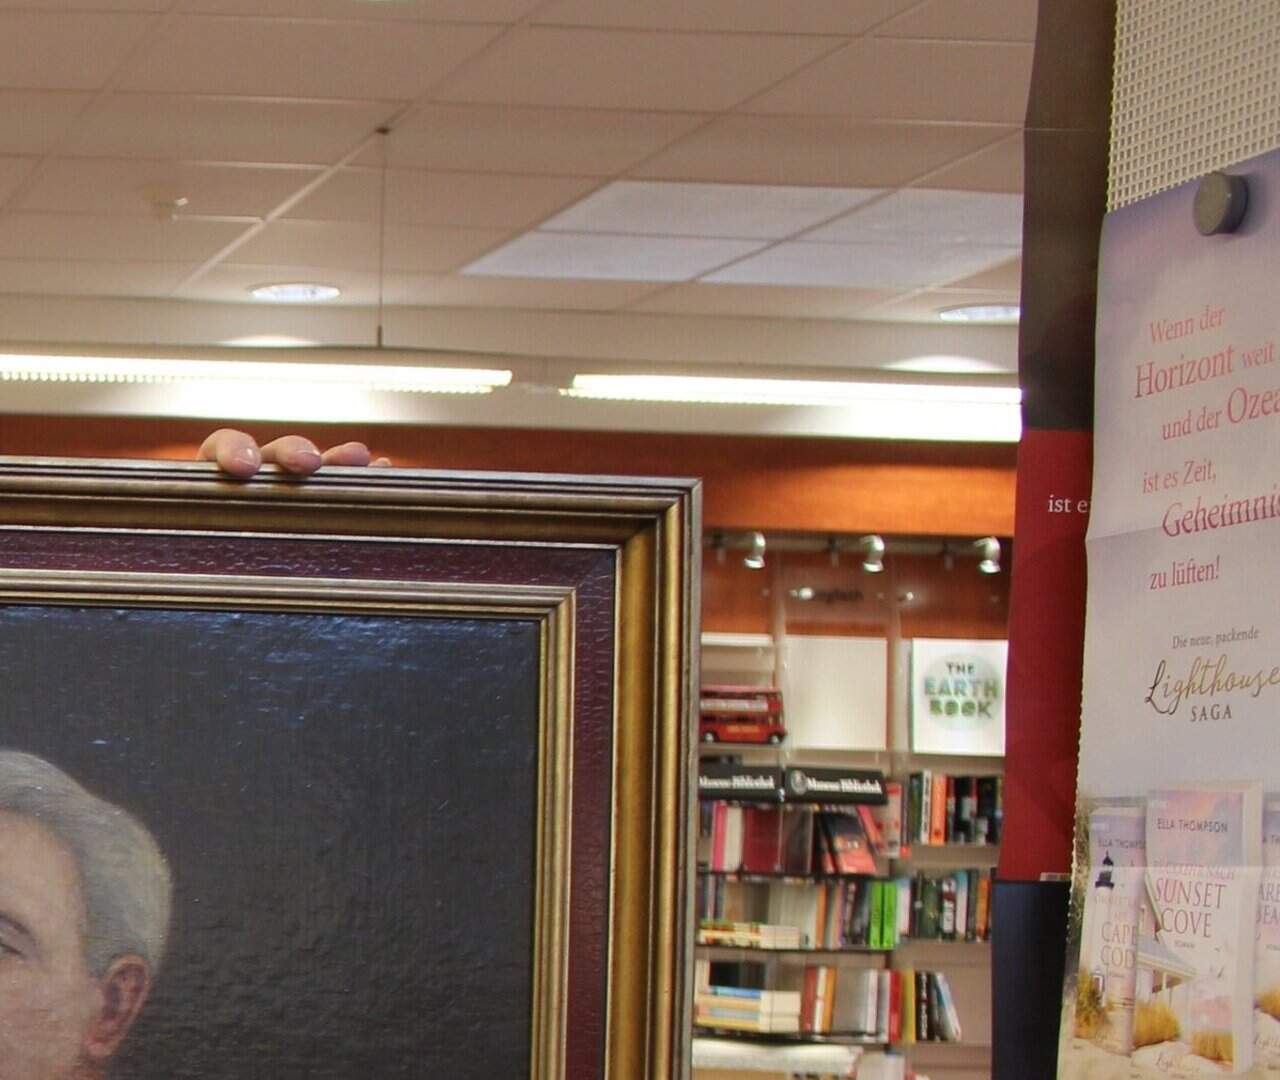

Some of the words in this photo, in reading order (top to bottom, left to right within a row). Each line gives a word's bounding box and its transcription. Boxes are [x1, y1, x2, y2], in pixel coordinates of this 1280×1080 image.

[1149, 317, 1195, 345] Wenn
[1199, 304, 1225, 331] der
[1134, 345, 1235, 399] Horizont
[1241, 341, 1276, 369] weit
[1161, 409, 1192, 441] und
[1196, 405, 1222, 432] der
[1142, 471, 1160, 494] ist
[1163, 471, 1178, 490] es
[1182, 457, 1217, 486] Zeit,
[1048, 494, 1071, 512] ist
[1149, 570, 1167, 590] zu
[1171, 554, 1221, 587] lüften!
[1172, 634, 1187, 649] Die
[1215, 624, 1260, 649] packende
[945, 661, 977, 674] THE
[923, 676, 998, 700] EARTH
[1144, 653, 1280, 715] Lighthouse
[929, 699, 992, 719] BOOK
[1190, 703, 1232, 723] SAGA
[1157, 817, 1175, 830] ELLA
[1178, 818, 1228, 833] THOMPSON
[1154, 878, 1227, 909] SUNSET
[1161, 908, 1212, 938] COVE
